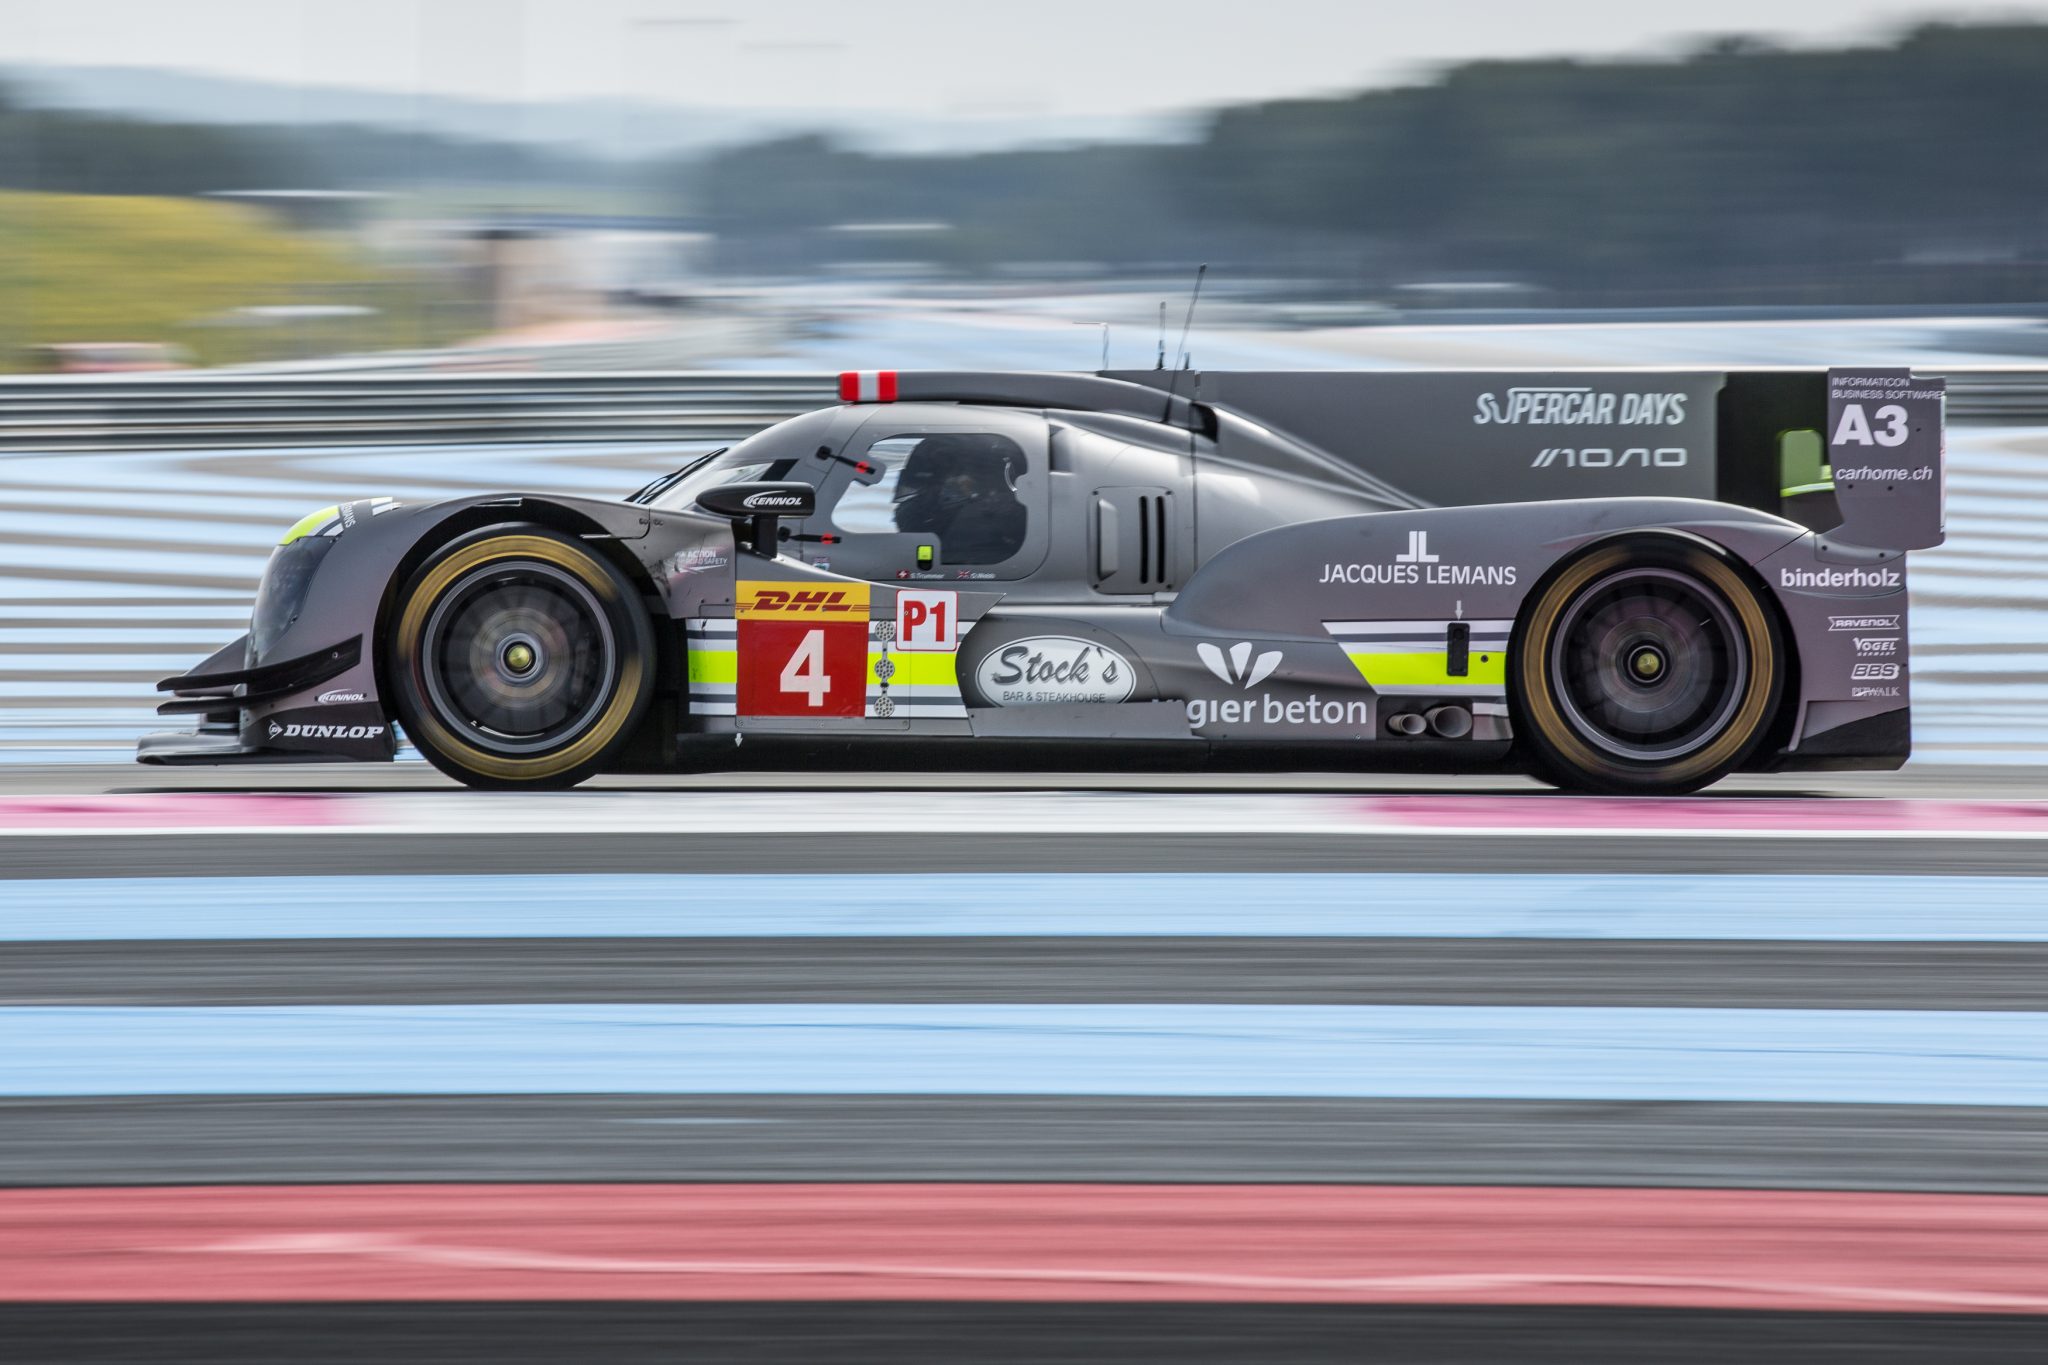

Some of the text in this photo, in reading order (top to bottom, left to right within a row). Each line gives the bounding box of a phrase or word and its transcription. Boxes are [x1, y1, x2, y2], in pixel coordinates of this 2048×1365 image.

[1831, 377, 1910, 387] INFORMATICON
[1831, 389, 1945, 400] BUSINESS SOFTWARE
[1473, 388, 1688, 425] SUPERCAR DAYS
[1831, 404, 1909, 447] A3
[1836, 466, 1933, 480] carhome.ch
[745, 494, 802, 507] KENNOL
[688, 550, 717, 558] ACTION
[704, 557, 728, 565] SAFETY
[1319, 564, 1517, 585] JACQUES LEMANS
[1781, 568, 1900, 587] binderholz
[754, 590, 852, 611] DHL
[903, 600, 946, 642] P1
[1834, 618, 1894, 628] RAVENOL
[1853, 637, 1899, 651] VOGEL
[780, 629, 831, 707] 4
[1852, 664, 1898, 679] BBS
[319, 691, 364, 703] KENNOL
[1003, 691, 1106, 703] BAR & STEAKHOUSE
[1263, 693, 1367, 724] beton
[283, 724, 384, 739] DUNLOP
